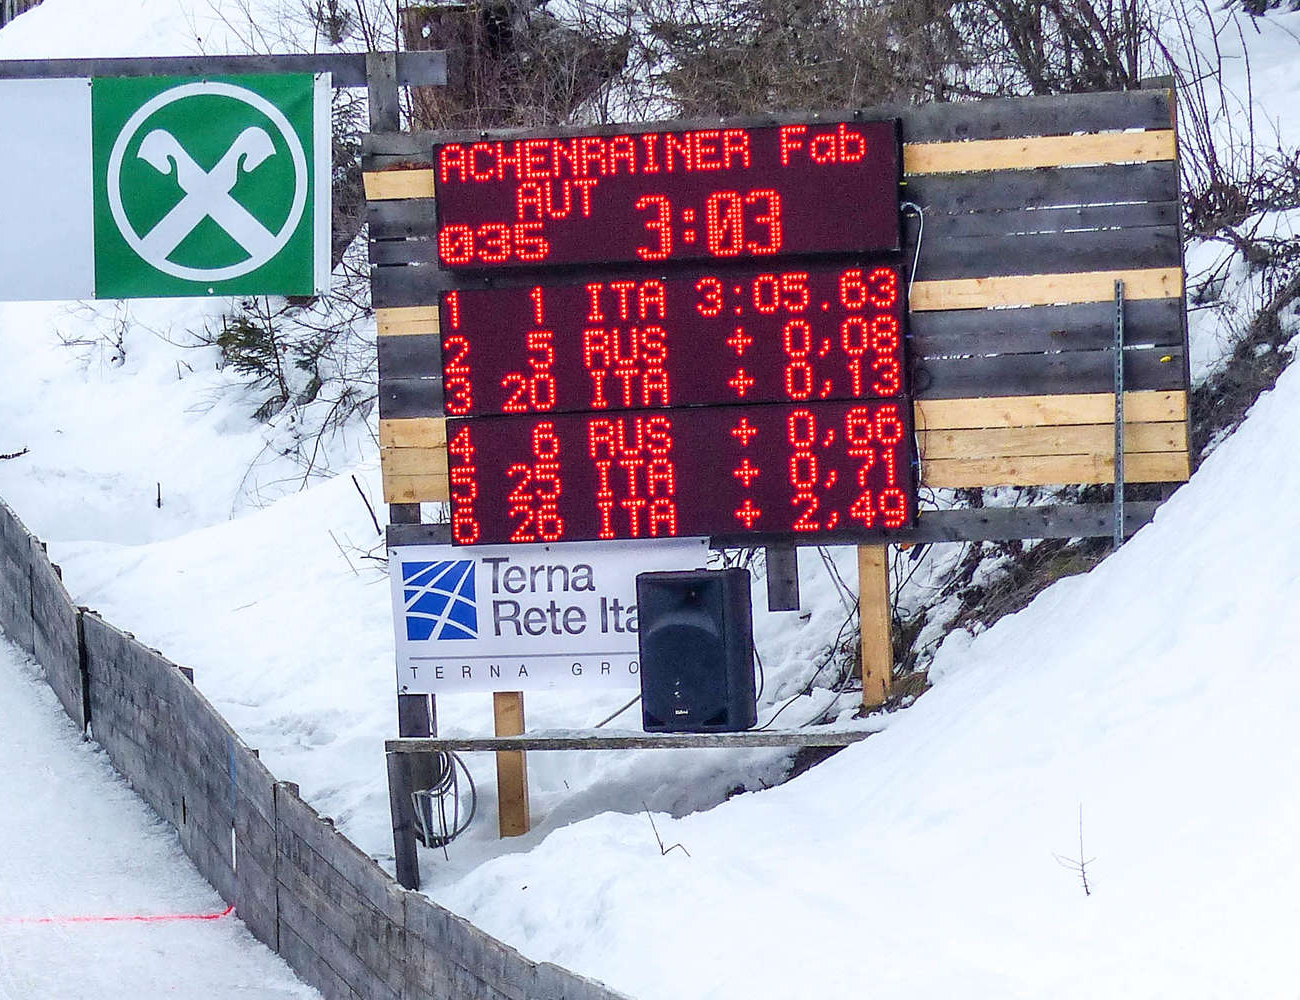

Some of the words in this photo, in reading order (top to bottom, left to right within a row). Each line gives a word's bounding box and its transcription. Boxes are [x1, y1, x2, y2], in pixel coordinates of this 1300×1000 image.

[439, 129, 750, 183] ACHENRAINER
[780, 123, 867, 165] Fab
[439, 222, 549, 264] 035
[635, 189, 782, 260] 3:03
[517, 179, 598, 218] AUT
[446, 291, 460, 329] 1
[530, 287, 543, 324] 1
[586, 280, 666, 322] ITA
[695, 268, 897, 317] 3:05.63
[445, 336, 470, 374] 2
[528, 332, 554, 369] 5
[584, 327, 667, 370] RUS
[783, 315, 900, 357] 0,08
[446, 376, 473, 415] 3
[501, 373, 556, 412] 20
[590, 368, 669, 409] ITA
[785, 357, 900, 400] 0,13
[449, 426, 475, 462] 4
[532, 422, 559, 460] 6
[588, 416, 673, 459] RUS
[788, 405, 903, 448] 0,66
[450, 466, 477, 503] 5
[507, 462, 562, 501] 25
[596, 459, 675, 499] ITA
[790, 449, 899, 490] 0,71
[452, 506, 479, 544] 6
[510, 503, 564, 542] 26
[598, 499, 676, 538] ITA
[793, 489, 907, 531] 2,49
[483, 557, 596, 595] Terna
[494, 599, 588, 637] Rete
[410, 665, 530, 679] TERNA
[572, 661, 639, 676] GRO
